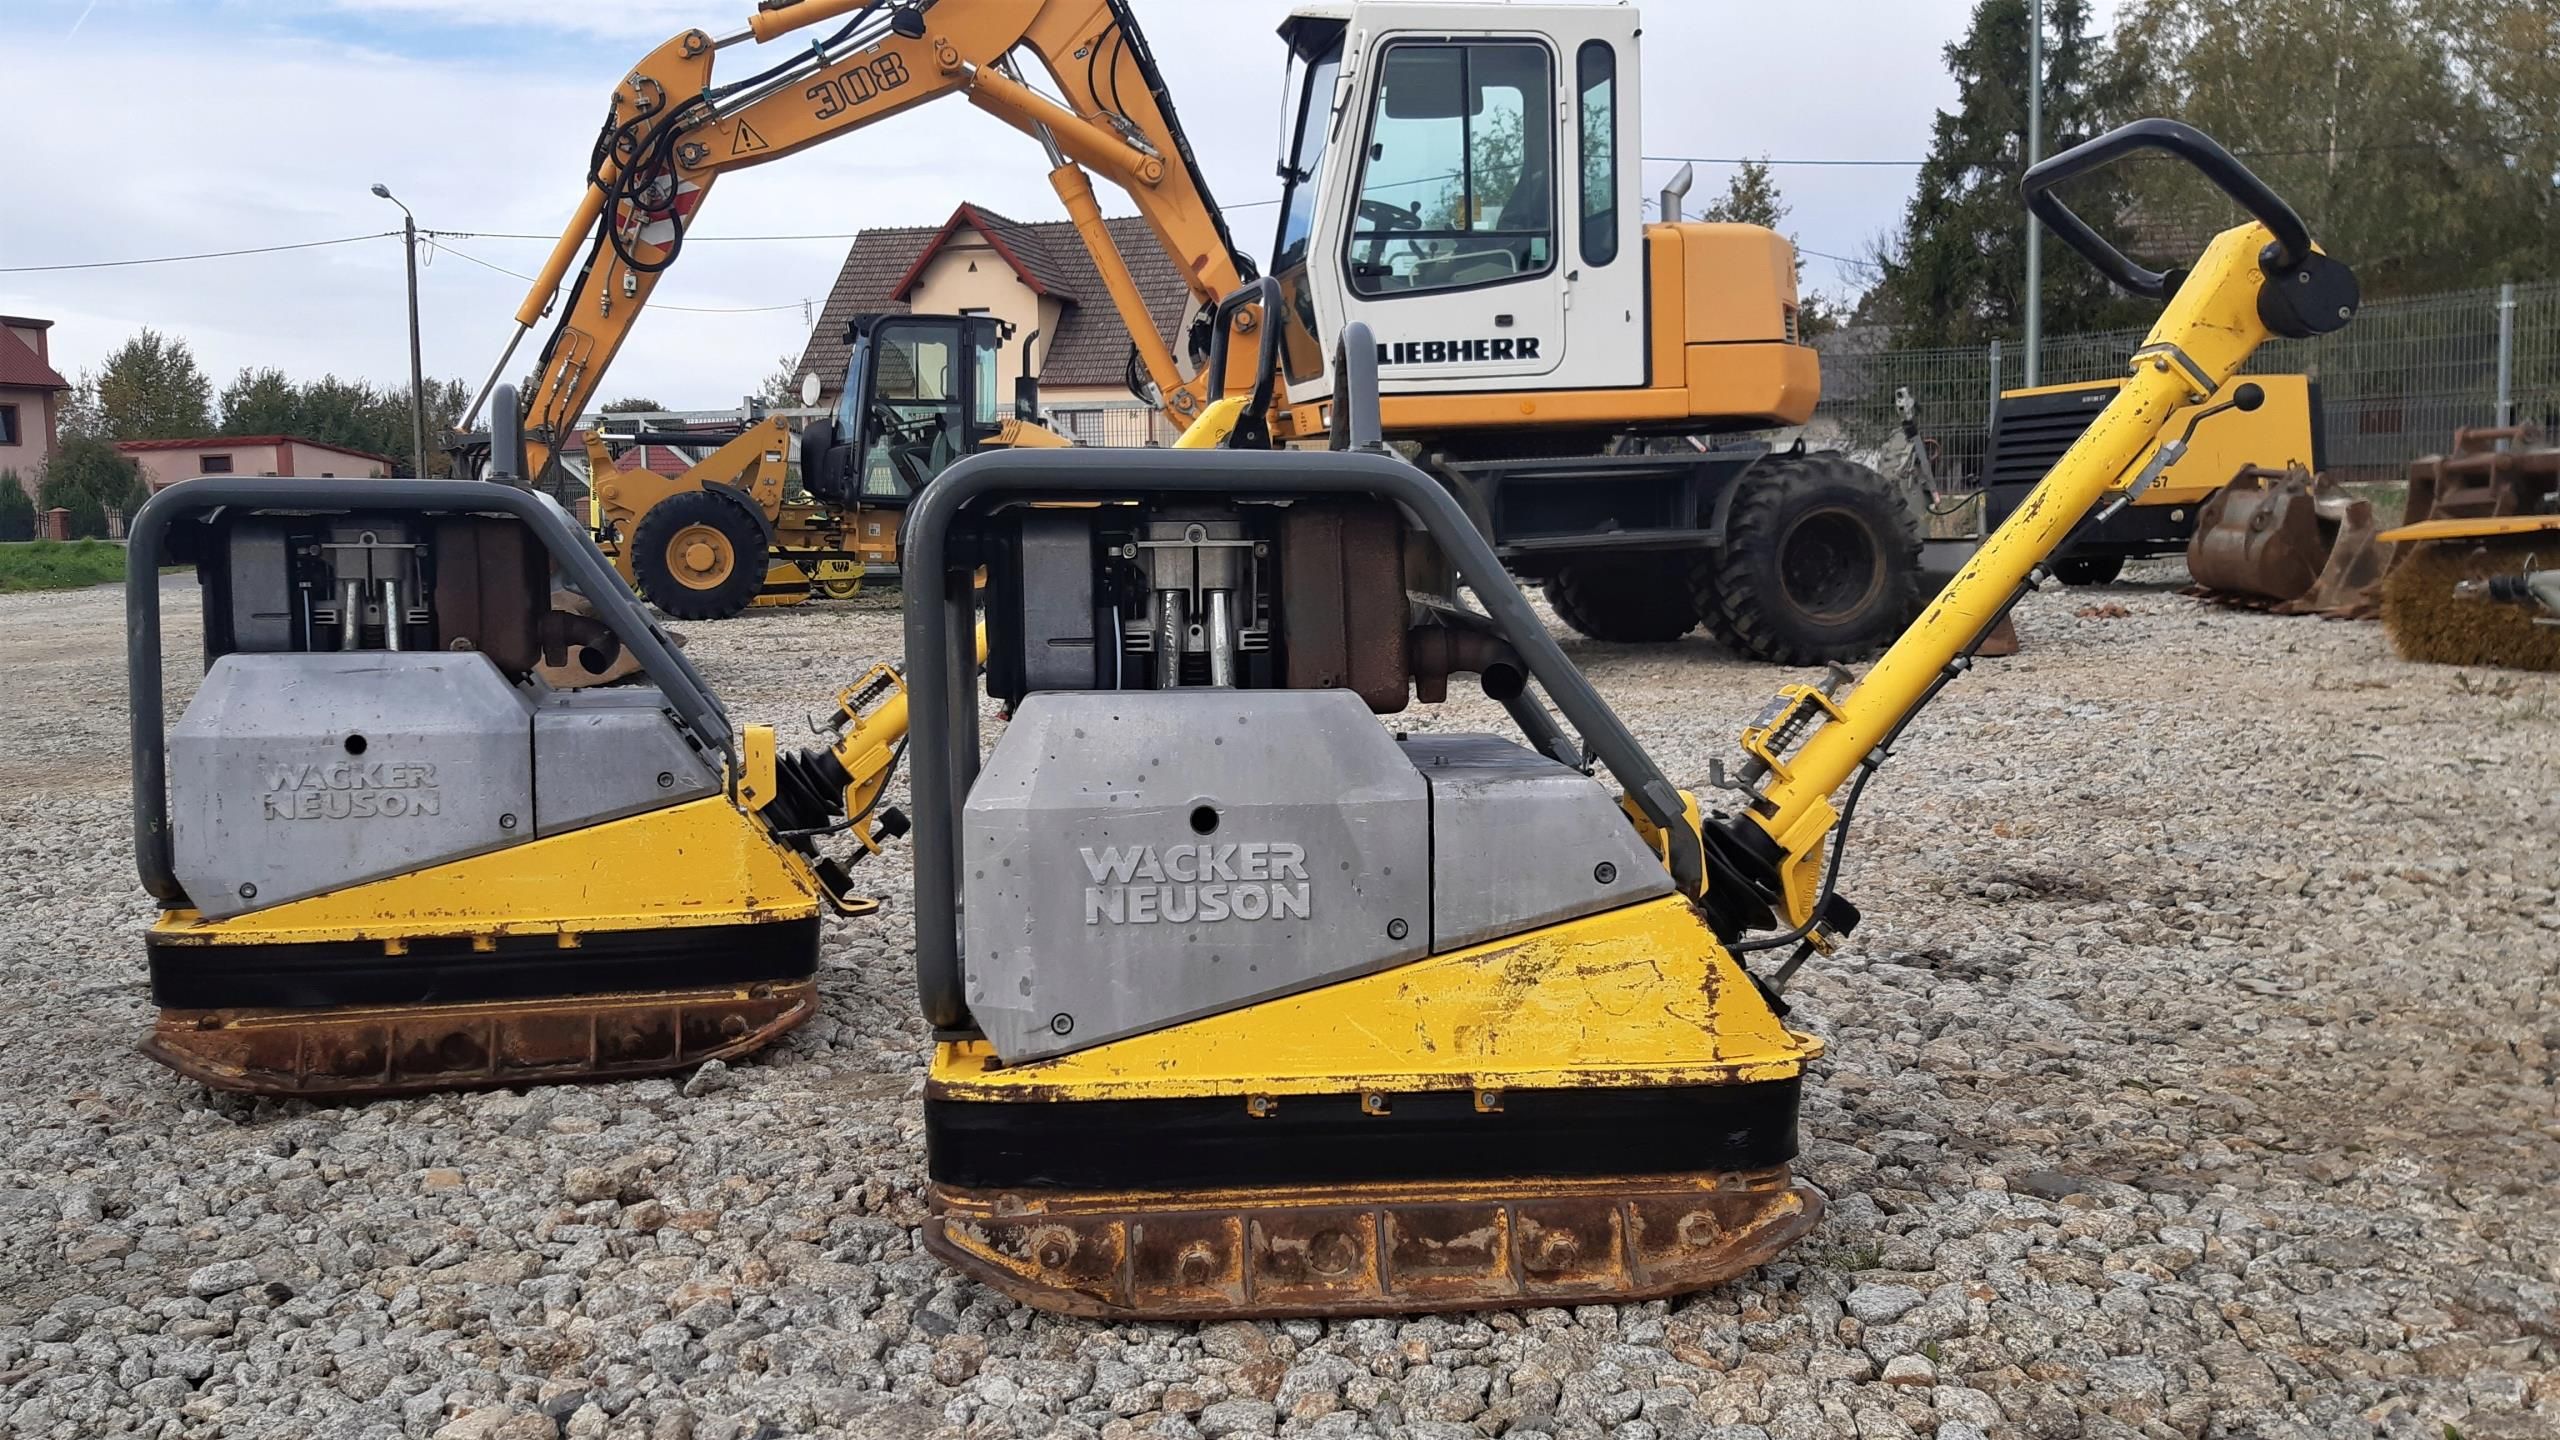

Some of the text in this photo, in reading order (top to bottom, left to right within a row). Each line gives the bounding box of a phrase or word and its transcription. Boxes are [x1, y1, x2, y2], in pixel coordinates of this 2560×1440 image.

[806, 51, 910, 120] 308
[1376, 337, 1541, 365] LIEBHERR
[2146, 475, 2169, 488] 57
[259, 763, 440, 791] WACKER
[263, 790, 441, 821] NEUSON
[1080, 843, 1310, 884] WACKER
[1085, 883, 1311, 924] NEUSON
